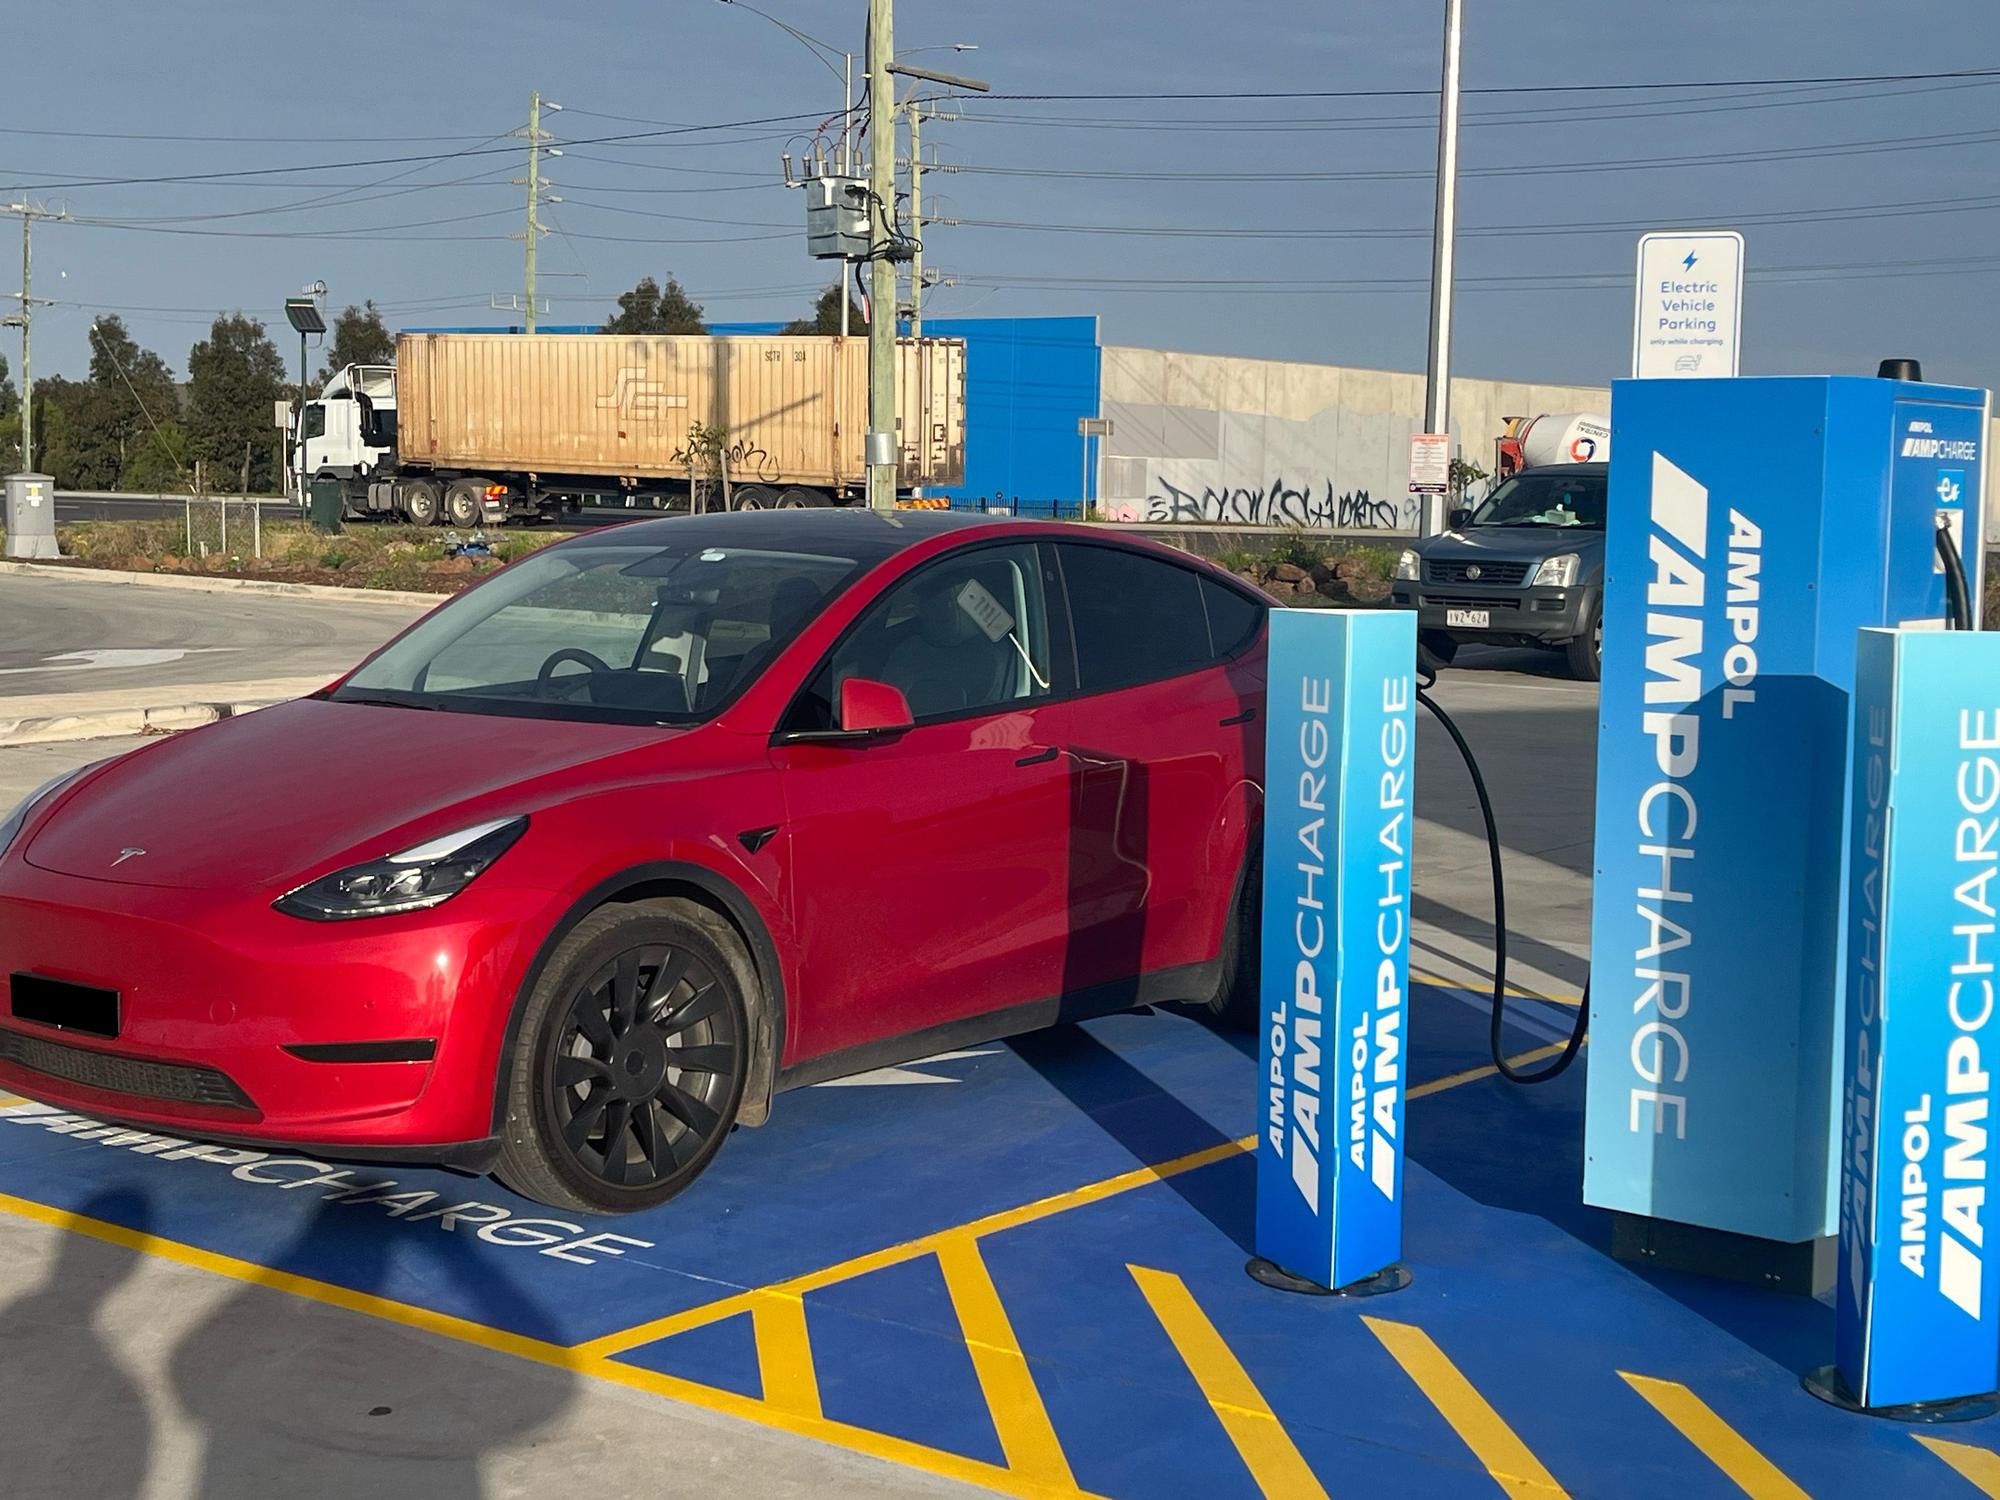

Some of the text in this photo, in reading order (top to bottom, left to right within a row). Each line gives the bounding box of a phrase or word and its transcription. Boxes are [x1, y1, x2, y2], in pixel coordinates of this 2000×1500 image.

[1650, 337, 1724, 346] only while charging
[1658, 317, 1717, 333] Parking
[1660, 280, 1718, 294] Electric
[1662, 299, 1716, 312] Vehicle
[1910, 438, 1976, 460] AMPCHARGE
[1722, 507, 1763, 719] AMPOL
[1293, 676, 1330, 1153] AMPCHARGE
[1373, 675, 1408, 1140] AMPCHARGE
[1629, 533, 1706, 1141] AMPCHARGE
[1852, 705, 1888, 1249] AMPCHARGE
[1941, 708, 2000, 1249] AMPCHARGE
[1269, 1001, 1286, 1159] AMPOL
[1350, 1011, 1369, 1172] AMPOL
[1900, 1094, 1931, 1279] AMPOL
